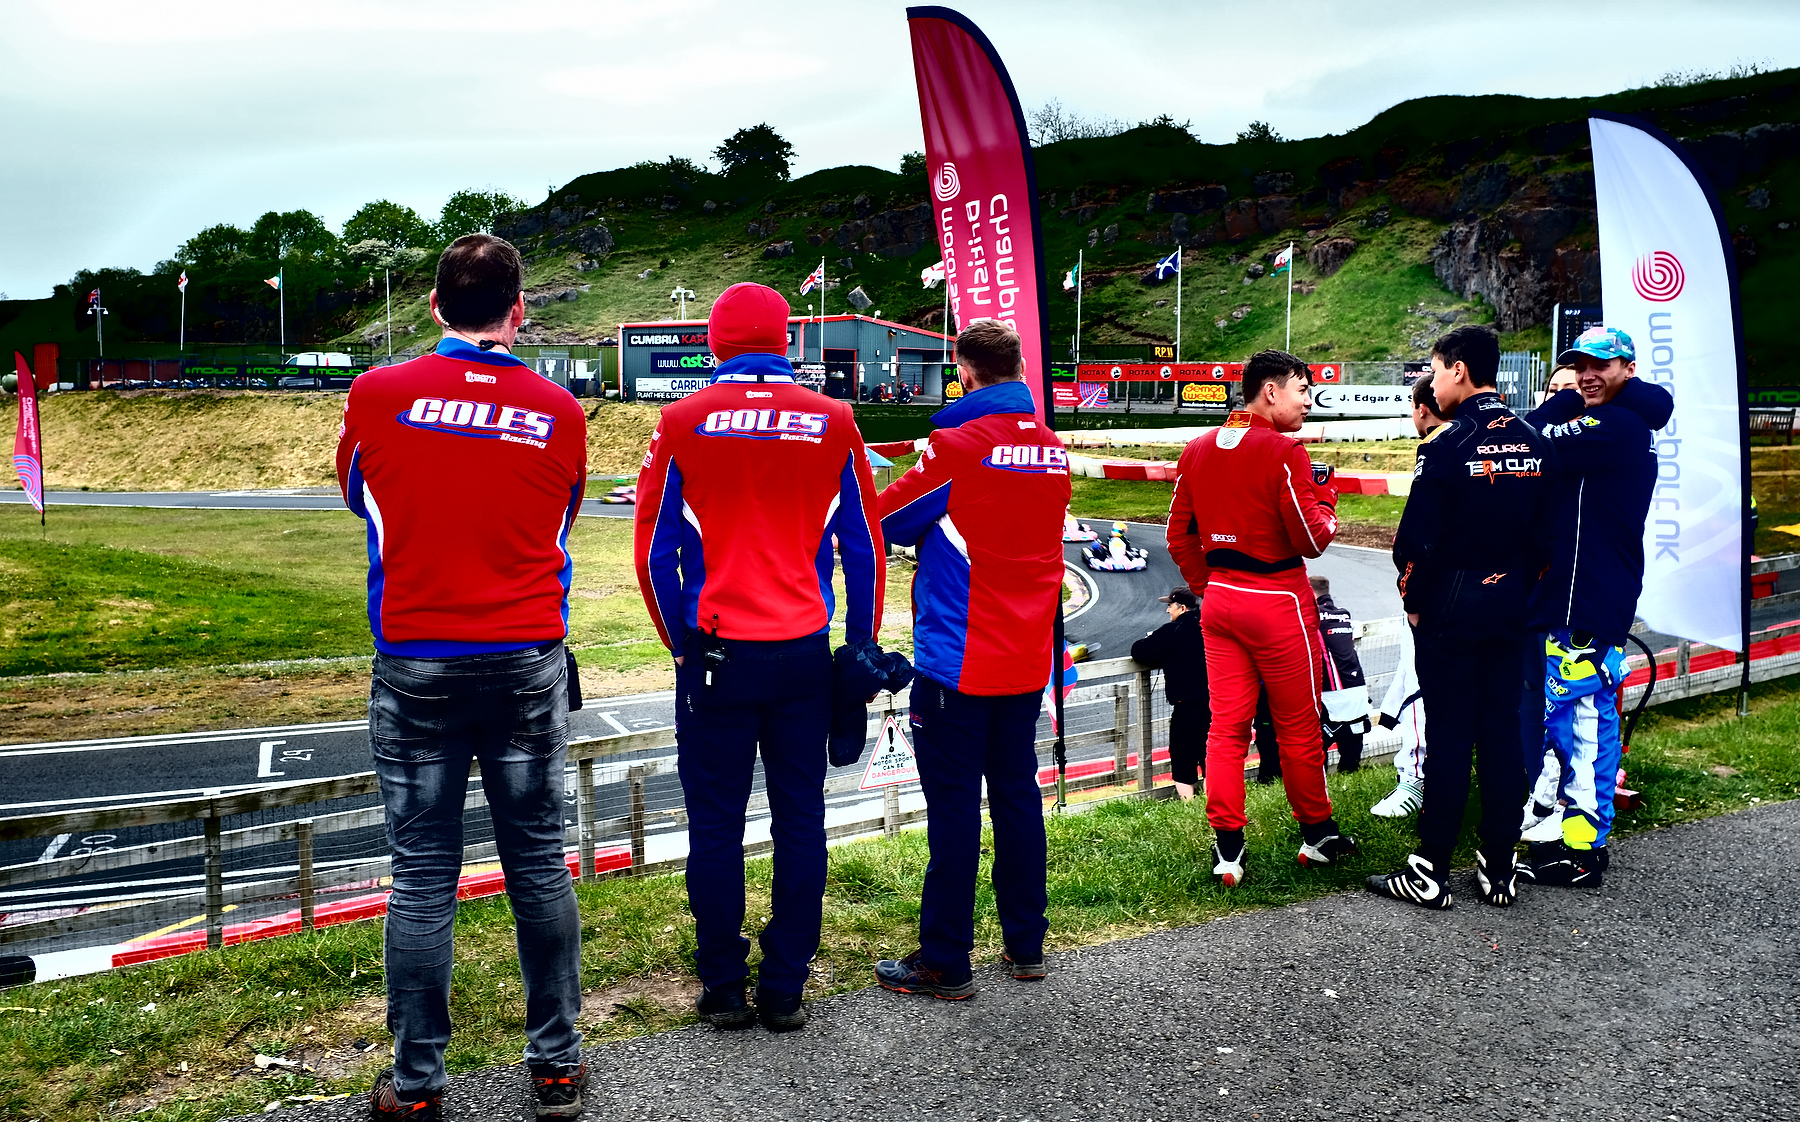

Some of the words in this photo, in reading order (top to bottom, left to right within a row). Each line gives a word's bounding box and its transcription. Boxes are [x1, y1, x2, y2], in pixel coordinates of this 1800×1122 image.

[630, 334, 680, 345] CUMBRIA
[1081, 369, 1107, 377] ROTAX
[1128, 369, 1156, 377] ROTAX
[671, 379, 710, 391] CARRUT
[1184, 383, 1225, 393] demon
[637, 391, 653, 399] PLANT
[1182, 391, 1227, 401] tweeks
[1339, 394, 1350, 402] J.
[1354, 394, 1390, 404] Edgar
[1394, 394, 1403, 402] &
[407, 397, 556, 440] COLES
[704, 409, 829, 435] COLES
[500, 432, 548, 449] Racing
[780, 432, 823, 444] Racing
[1477, 443, 1531, 454] ROURKE
[990, 444, 1068, 467] COLES
[1465, 460, 1503, 477] TEAM
[1211, 533, 1237, 543] sparco
[1546, 675, 1569, 698] DHR
[872, 758, 893, 766] MOTOR
[895, 755, 913, 763] SPORT
[871, 765, 917, 779] DANGEROUS
